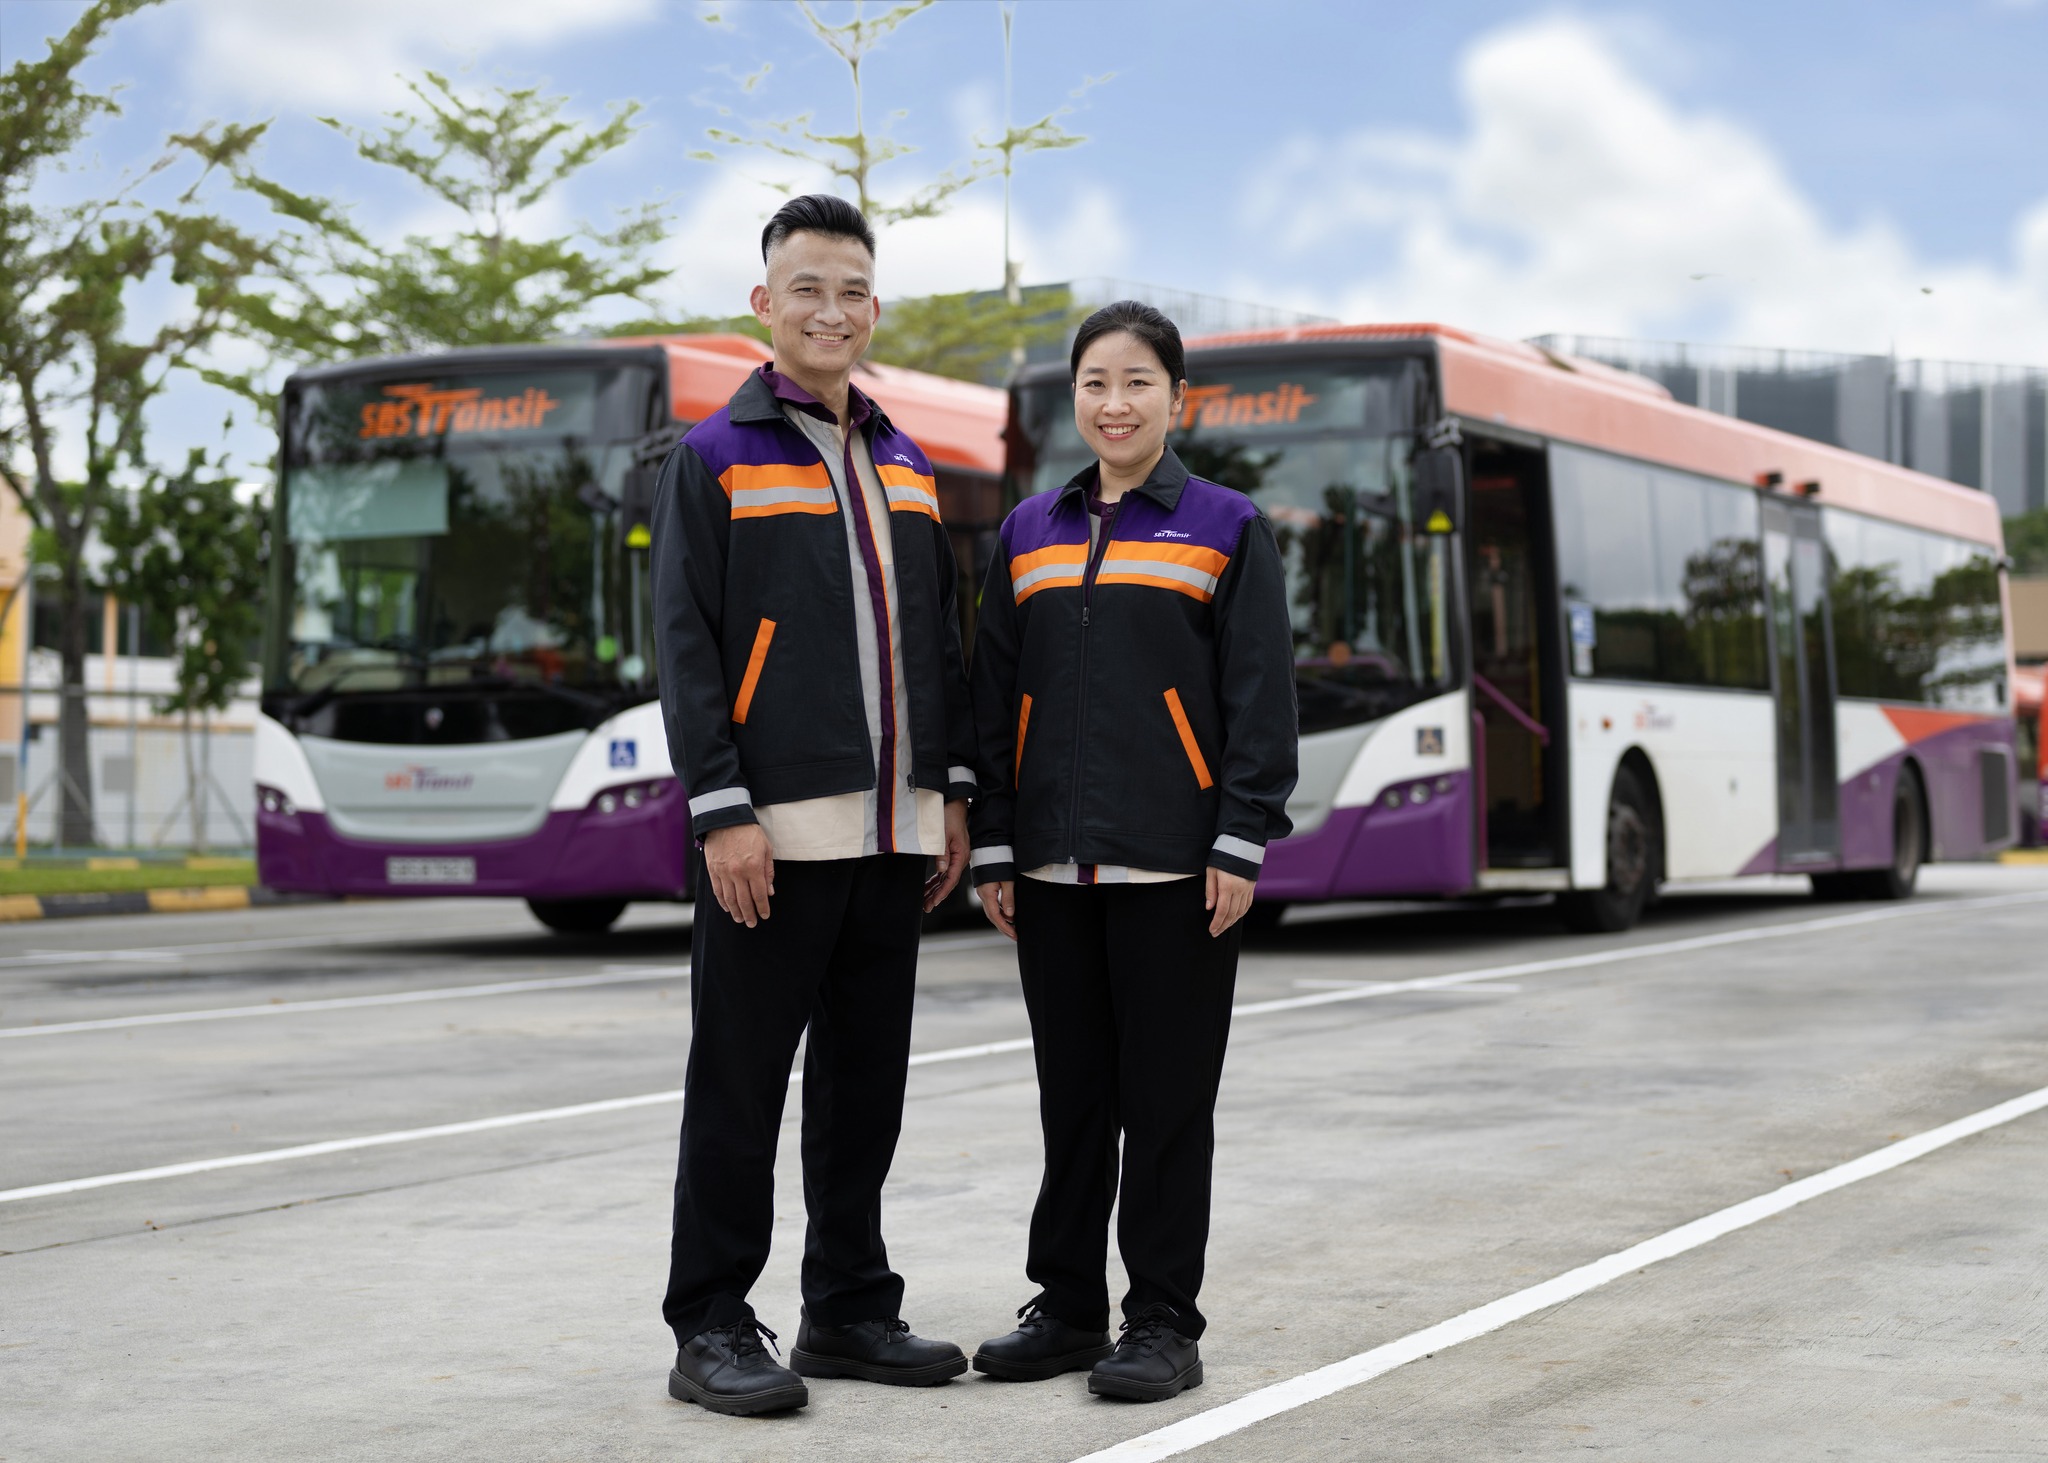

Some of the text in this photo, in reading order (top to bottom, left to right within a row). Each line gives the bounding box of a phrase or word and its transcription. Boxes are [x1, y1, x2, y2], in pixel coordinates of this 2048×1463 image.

[360, 383, 559, 439] SBS Transit
[1161, 530, 1191, 538] Transit
